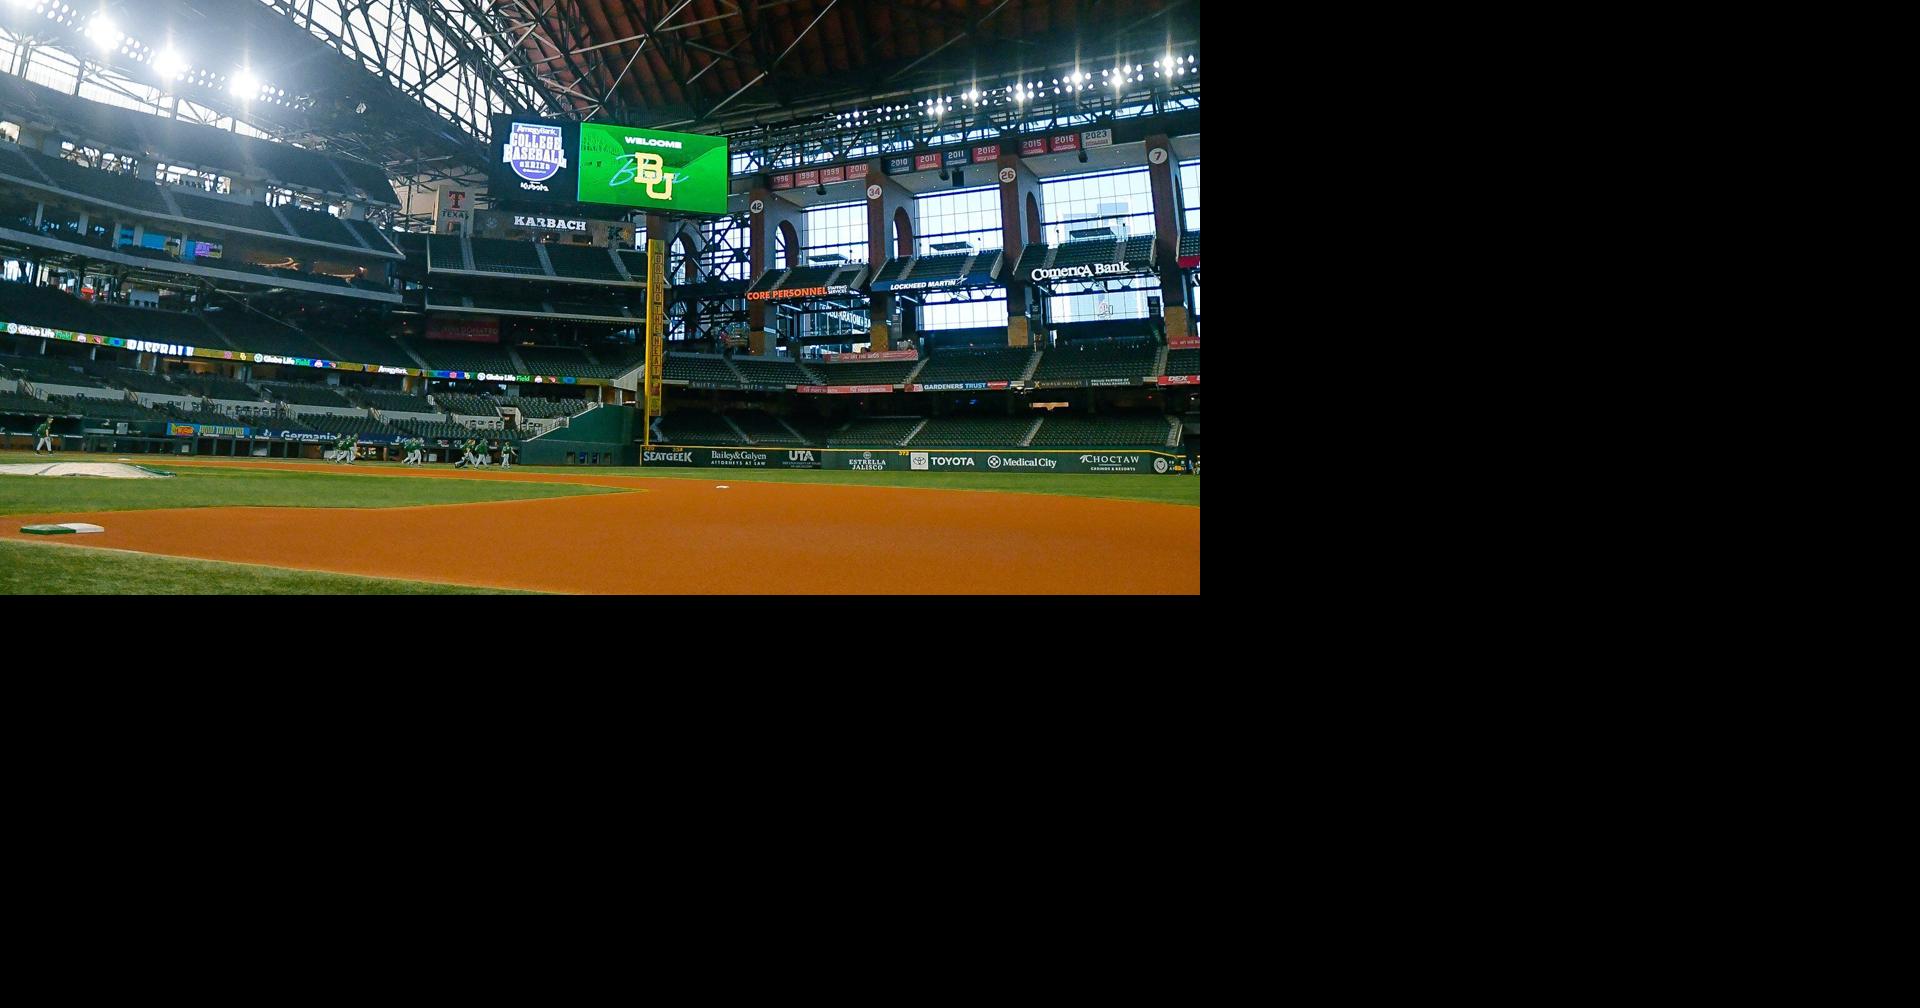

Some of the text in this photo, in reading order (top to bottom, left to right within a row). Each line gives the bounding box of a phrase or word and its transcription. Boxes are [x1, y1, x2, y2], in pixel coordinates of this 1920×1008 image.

[1085, 130, 1107, 139] 2023
[511, 133, 561, 150] COLLEGE
[625, 136, 682, 149] WELCOME
[1023, 139, 1042, 148] 2015
[1054, 135, 1074, 144] 2016
[977, 146, 996, 154] 2012
[503, 145, 566, 167] BASEBALL
[920, 155, 936, 163] 2011
[948, 151, 964, 159] 2011
[1153, 152, 1162, 161] 7
[891, 158, 908, 166] 2010
[850, 163, 867, 172] 2010
[634, 152, 674, 200] BU
[1001, 171, 1013, 180] 26
[868, 188, 880, 197] 34
[751, 202, 762, 210] 42
[514, 215, 587, 231] KARBACH
[1094, 261, 1129, 275] Bank
[890, 279, 956, 290] LOCKHEED MARTIN
[747, 287, 827, 300] CORE PERSONNEL
[17, 324, 71, 339] Globe Life Field
[263, 355, 282, 364] Globe
[282, 356, 295, 365] Life
[486, 373, 504, 381] Globe
[516, 375, 530, 383] Field
[281, 430, 338, 441] Germania
[643, 451, 692, 463] SEATGEEK
[711, 451, 767, 460] Bailey&Galyen
[789, 450, 814, 461] UTA
[1086, 455, 1139, 463] CHOCTAW
[931, 457, 975, 466] TOYOTA
[1003, 458, 1057, 468] Medical City
